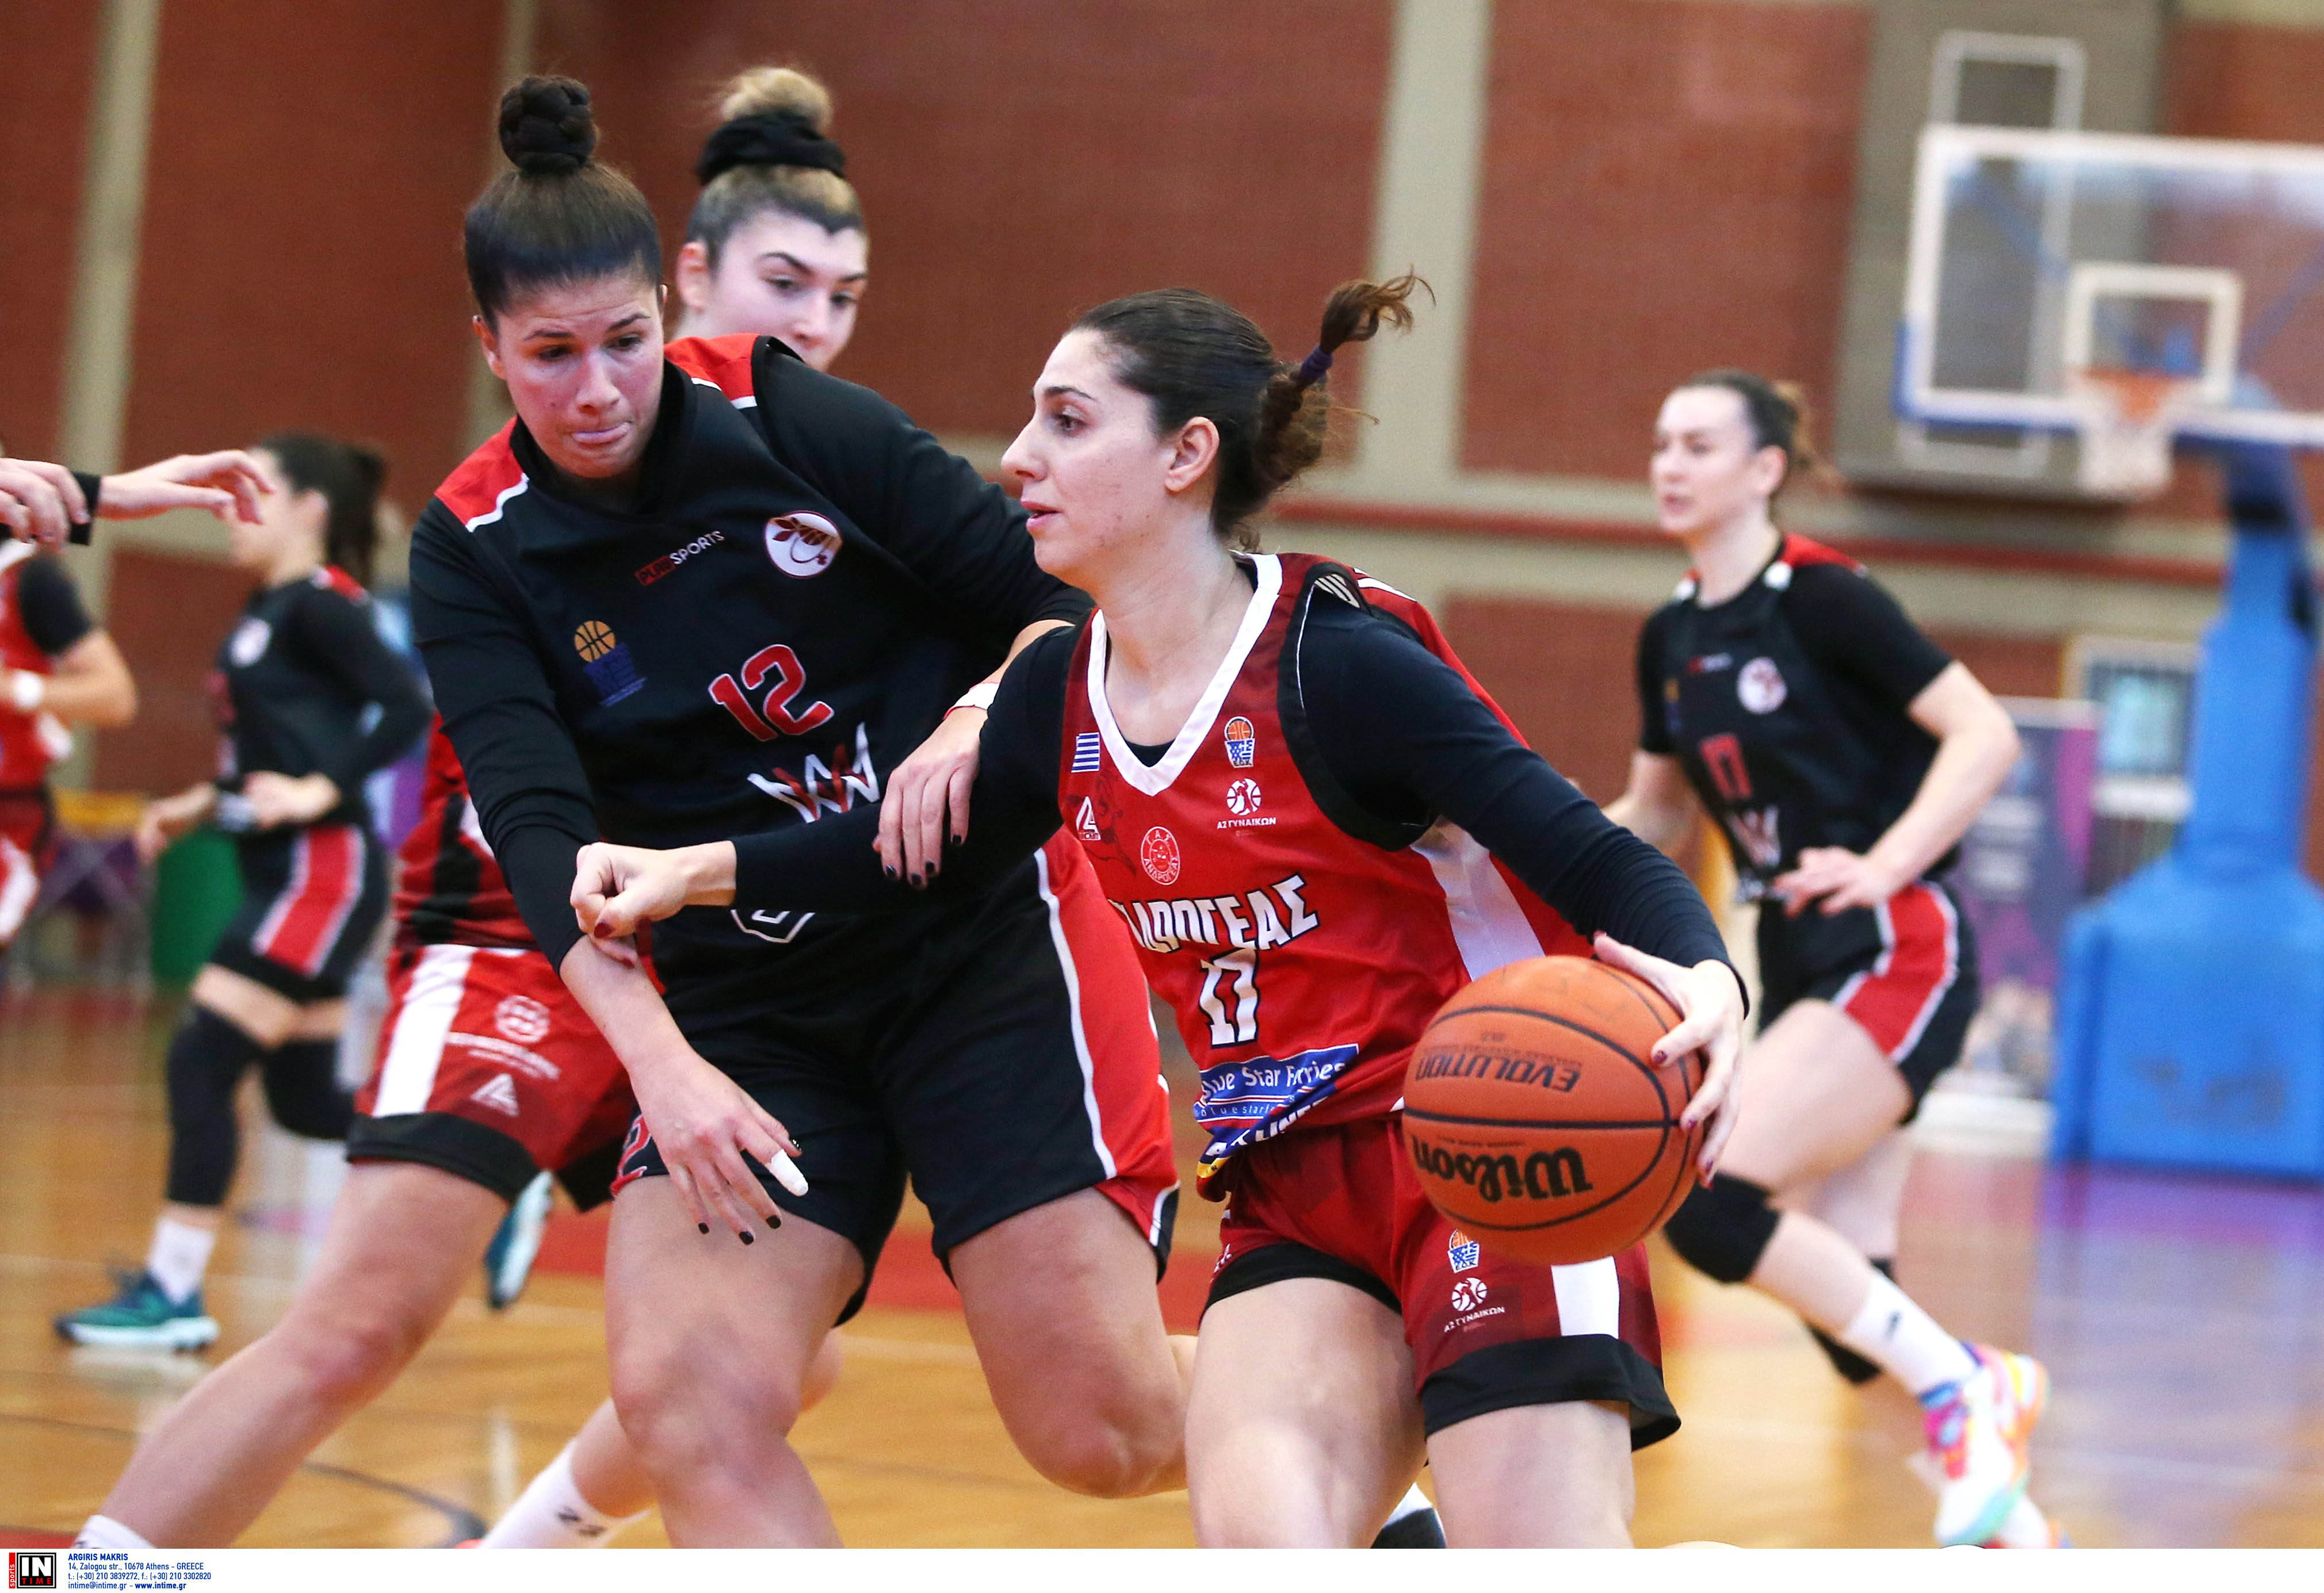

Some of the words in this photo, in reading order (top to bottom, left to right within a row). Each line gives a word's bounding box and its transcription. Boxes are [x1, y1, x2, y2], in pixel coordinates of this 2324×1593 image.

[670, 530, 725, 565] SPORTS
[709, 644, 835, 742] 12
[1241, 1066, 1281, 1087] Star
[1415, 1052, 1581, 1093] EVOLUTION
[1412, 1135, 1593, 1204] Wilson
